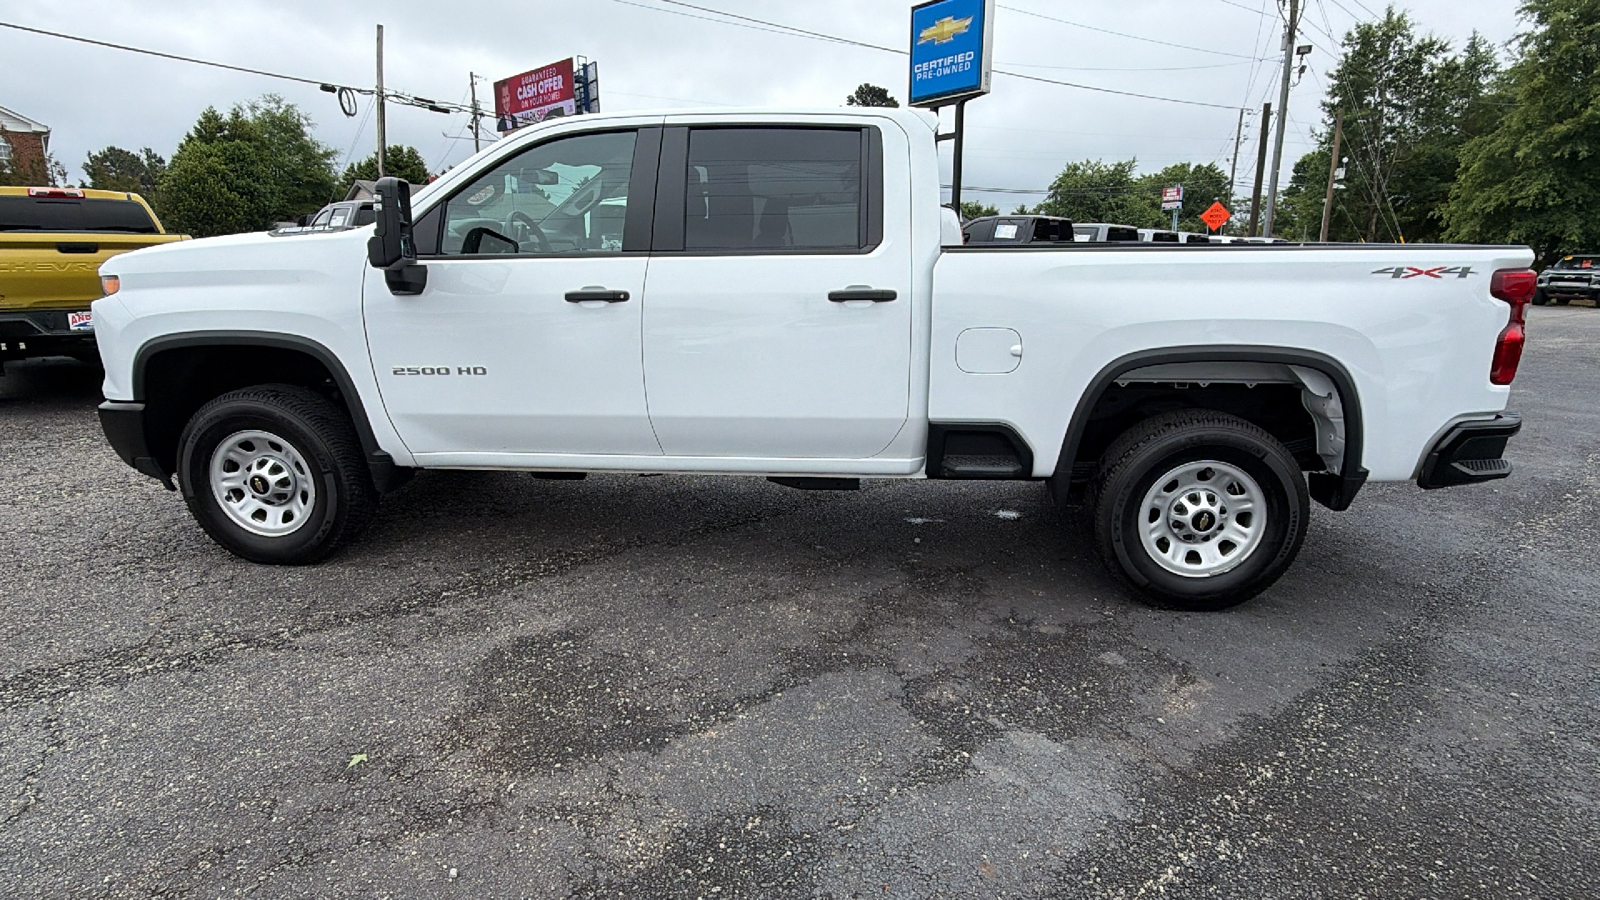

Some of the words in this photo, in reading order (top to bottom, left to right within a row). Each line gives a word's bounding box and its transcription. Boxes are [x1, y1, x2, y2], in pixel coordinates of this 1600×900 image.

[914, 51, 974, 73] CERTIFIED
[916, 61, 971, 81] PRE-OWNED
[521, 67, 557, 85] GUARANTEED
[517, 82, 538, 100] CASH
[538, 75, 563, 93] OFFER
[521, 99, 529, 109] ON
[529, 95, 543, 106] YOUR
[391, 366, 451, 376] 2500
[457, 366, 488, 376] HD
